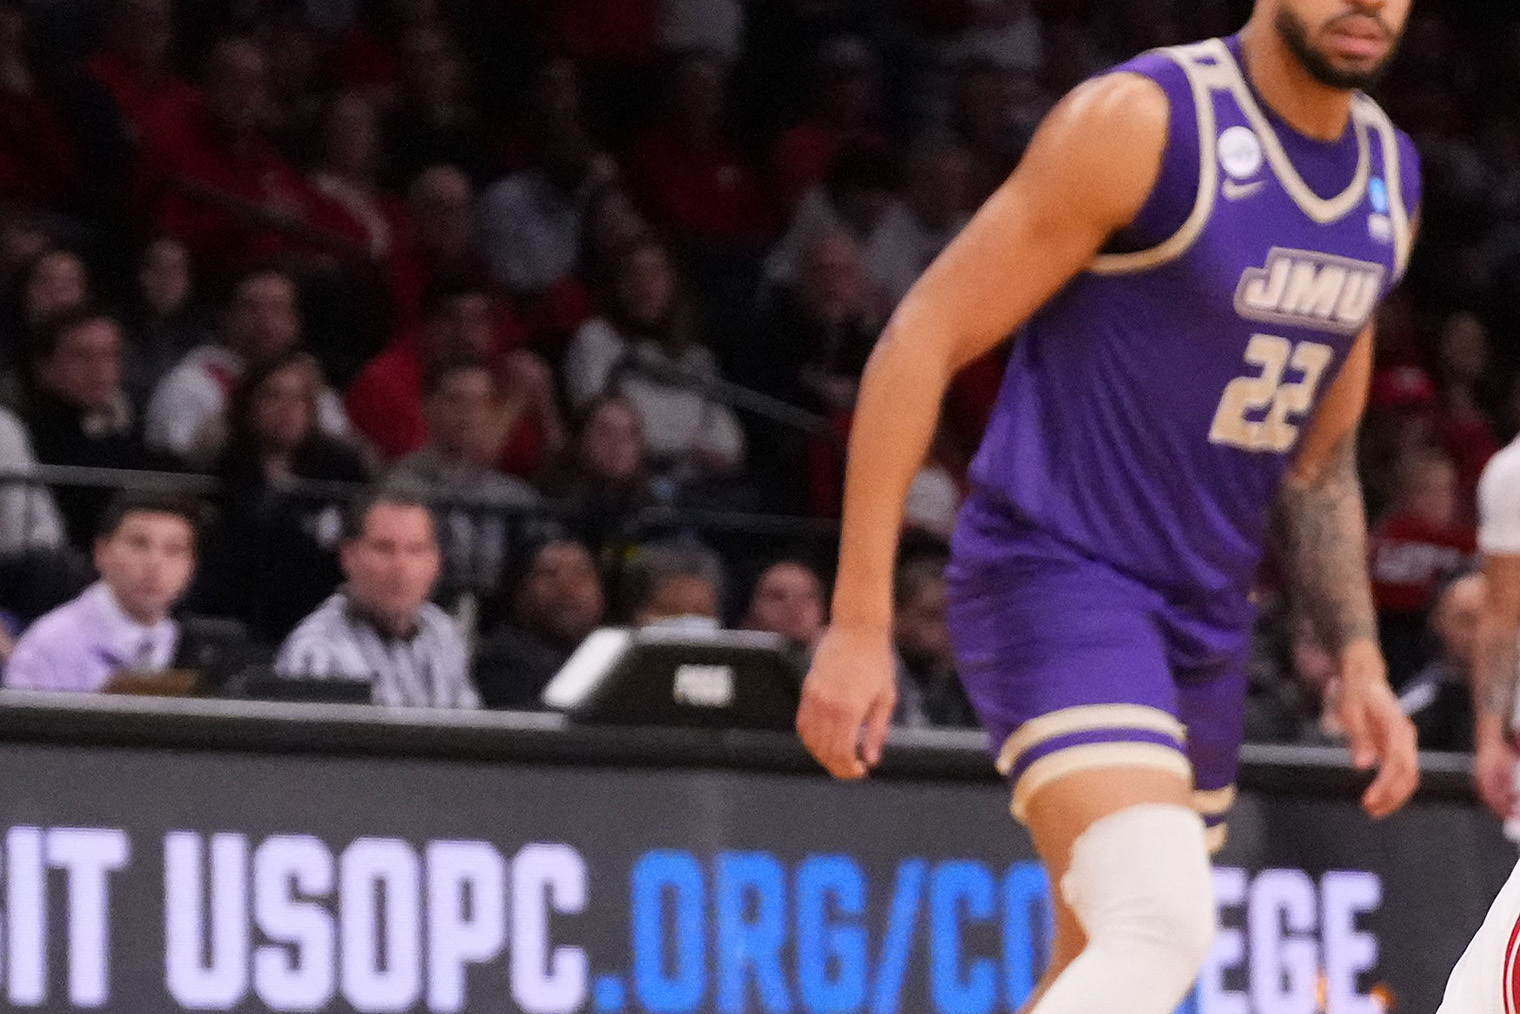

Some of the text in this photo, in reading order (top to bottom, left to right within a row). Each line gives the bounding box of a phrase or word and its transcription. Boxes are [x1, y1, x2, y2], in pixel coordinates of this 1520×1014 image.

[1238, 252, 1384, 330] JMU
[1207, 333, 1334, 452] 22
[0, 826, 130, 1008] IT
